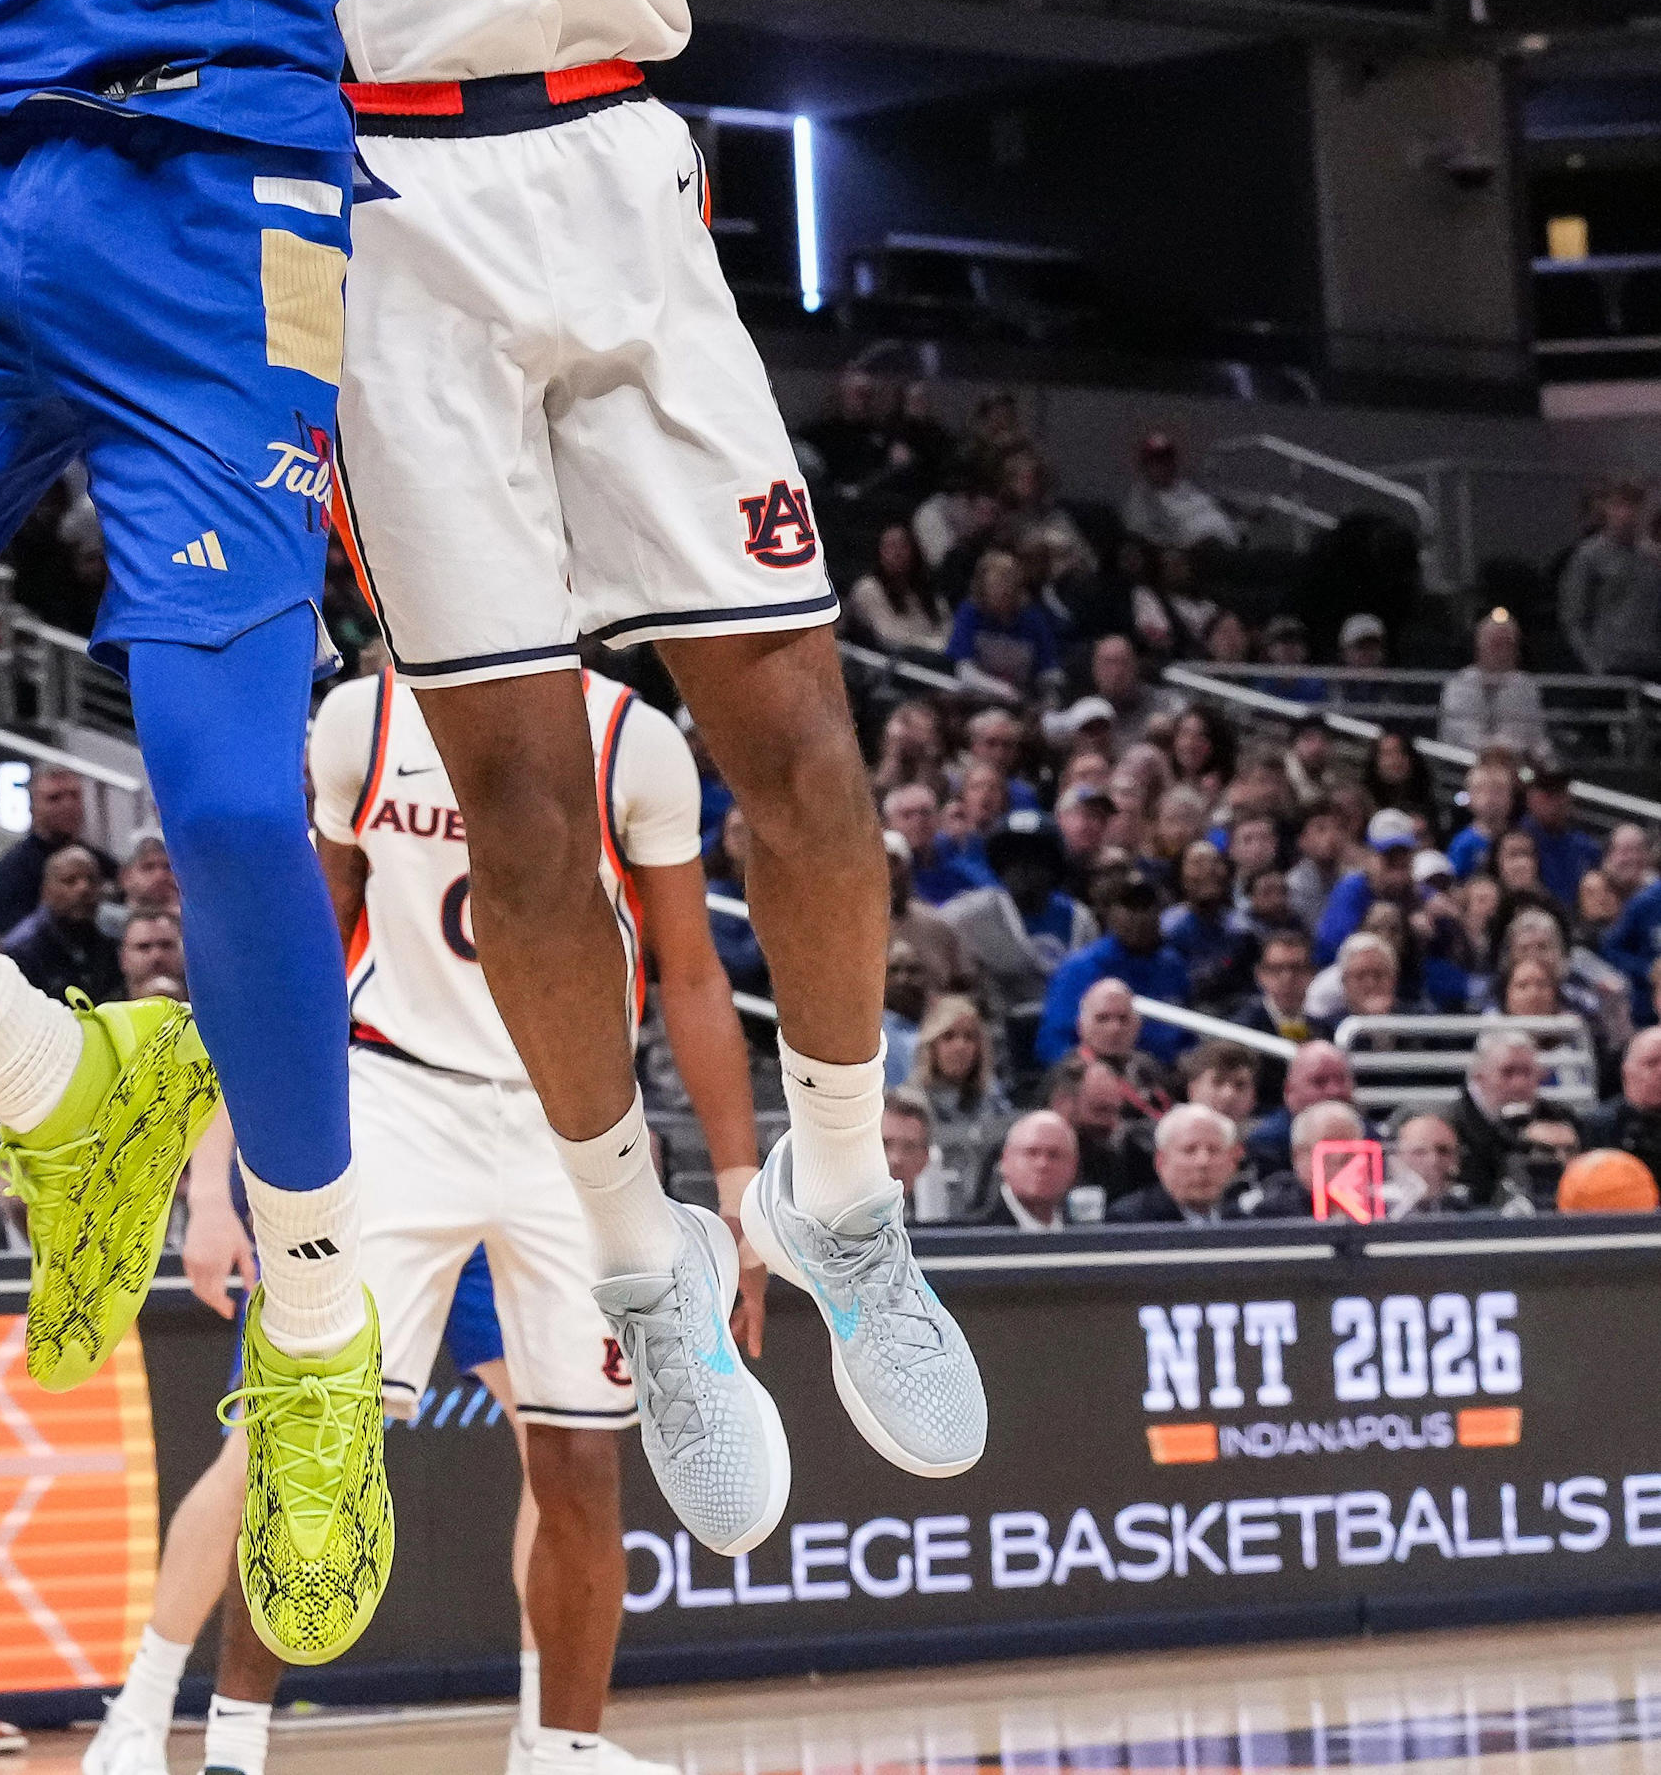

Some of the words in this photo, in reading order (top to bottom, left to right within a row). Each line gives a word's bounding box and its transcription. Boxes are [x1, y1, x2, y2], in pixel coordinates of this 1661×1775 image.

[370, 800, 467, 842] AUB
[1138, 1299, 1298, 1412] NIT
[1330, 1291, 1523, 1401] 2026
[1219, 1410, 1455, 1460] INDIANAPOLIS
[621, 1513, 973, 1614] OLLEGE
[989, 1475, 1613, 1590] BASKETBALL'S
